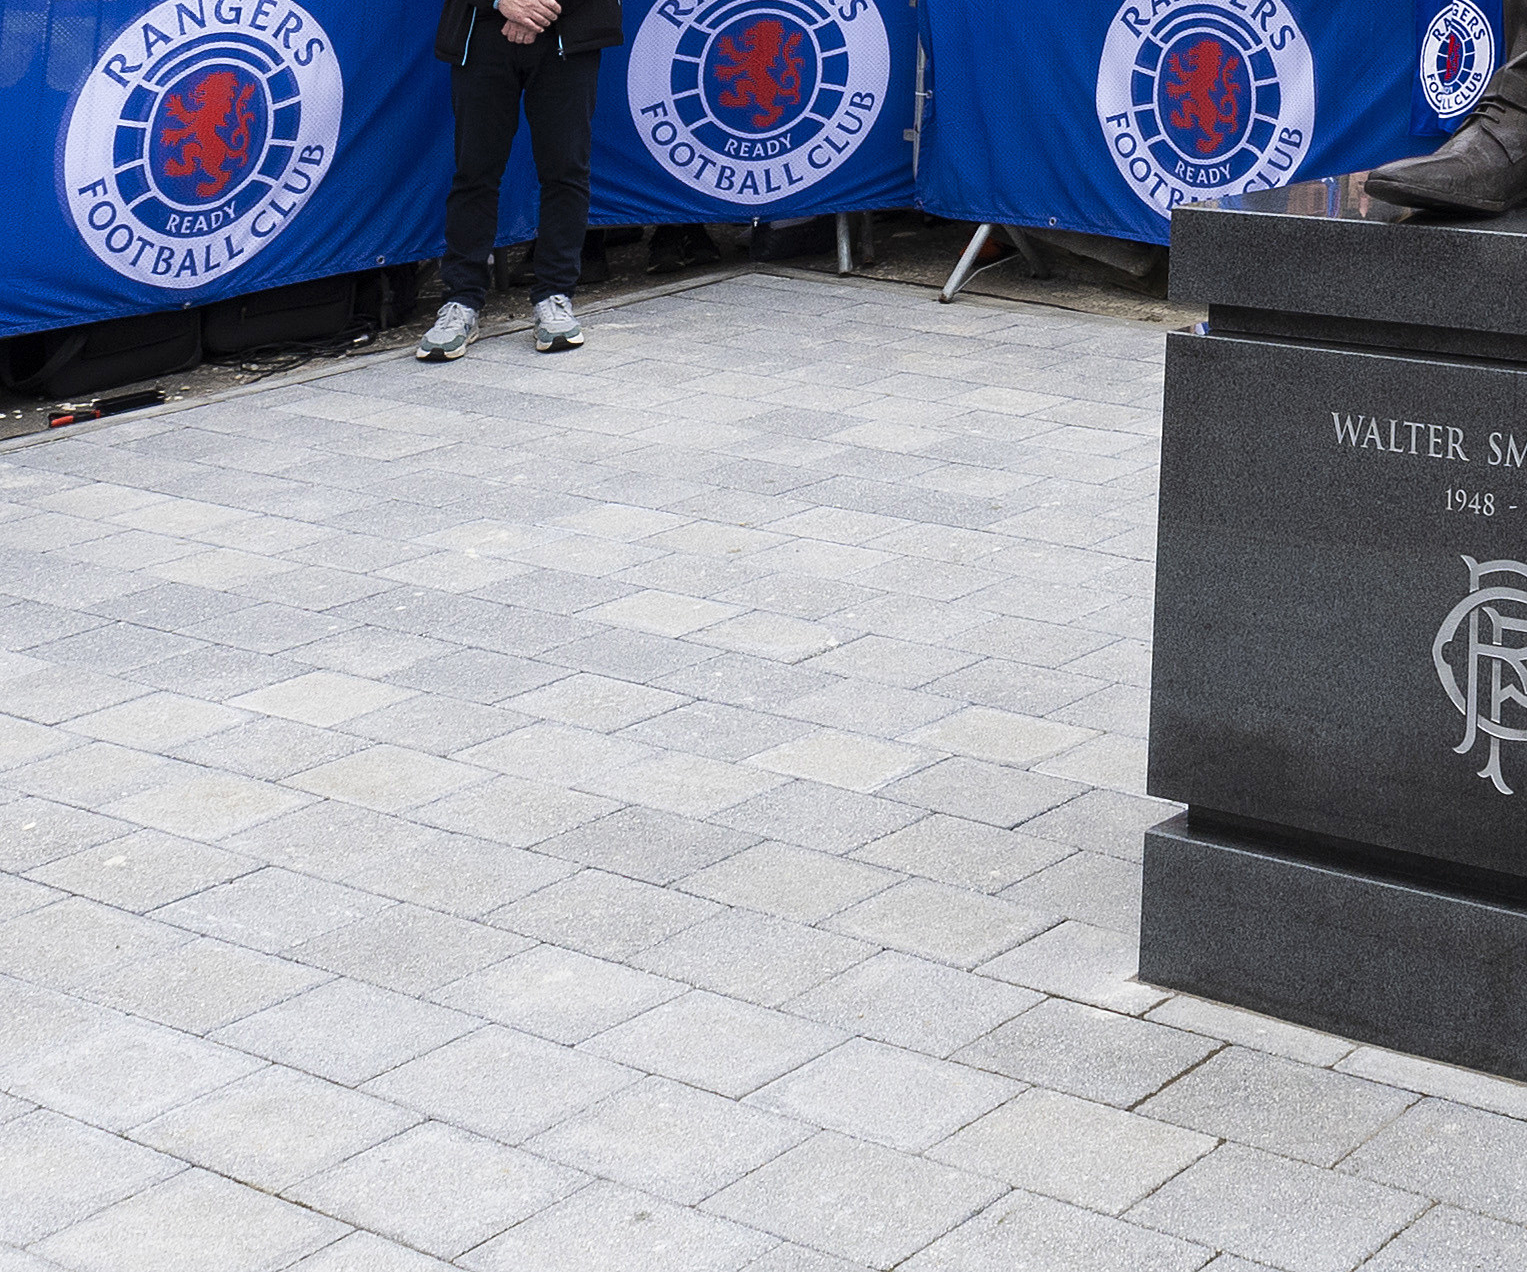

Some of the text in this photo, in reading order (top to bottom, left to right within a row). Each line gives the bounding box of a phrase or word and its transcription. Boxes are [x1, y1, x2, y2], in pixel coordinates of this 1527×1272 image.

[1432, 2, 1486, 41] RAGERS
[1454, 72, 1483, 105] CLUB
[640, 90, 876, 196] FOOTBALL CLUB
[724, 133, 792, 158] READY
[1174, 160, 1232, 185] READY
[78, 143, 325, 278] FOOTBALL CLUB
[165, 200, 239, 235] READY
[1330, 411, 1470, 462] WALTER
[1445, 487, 1496, 517] 1948
